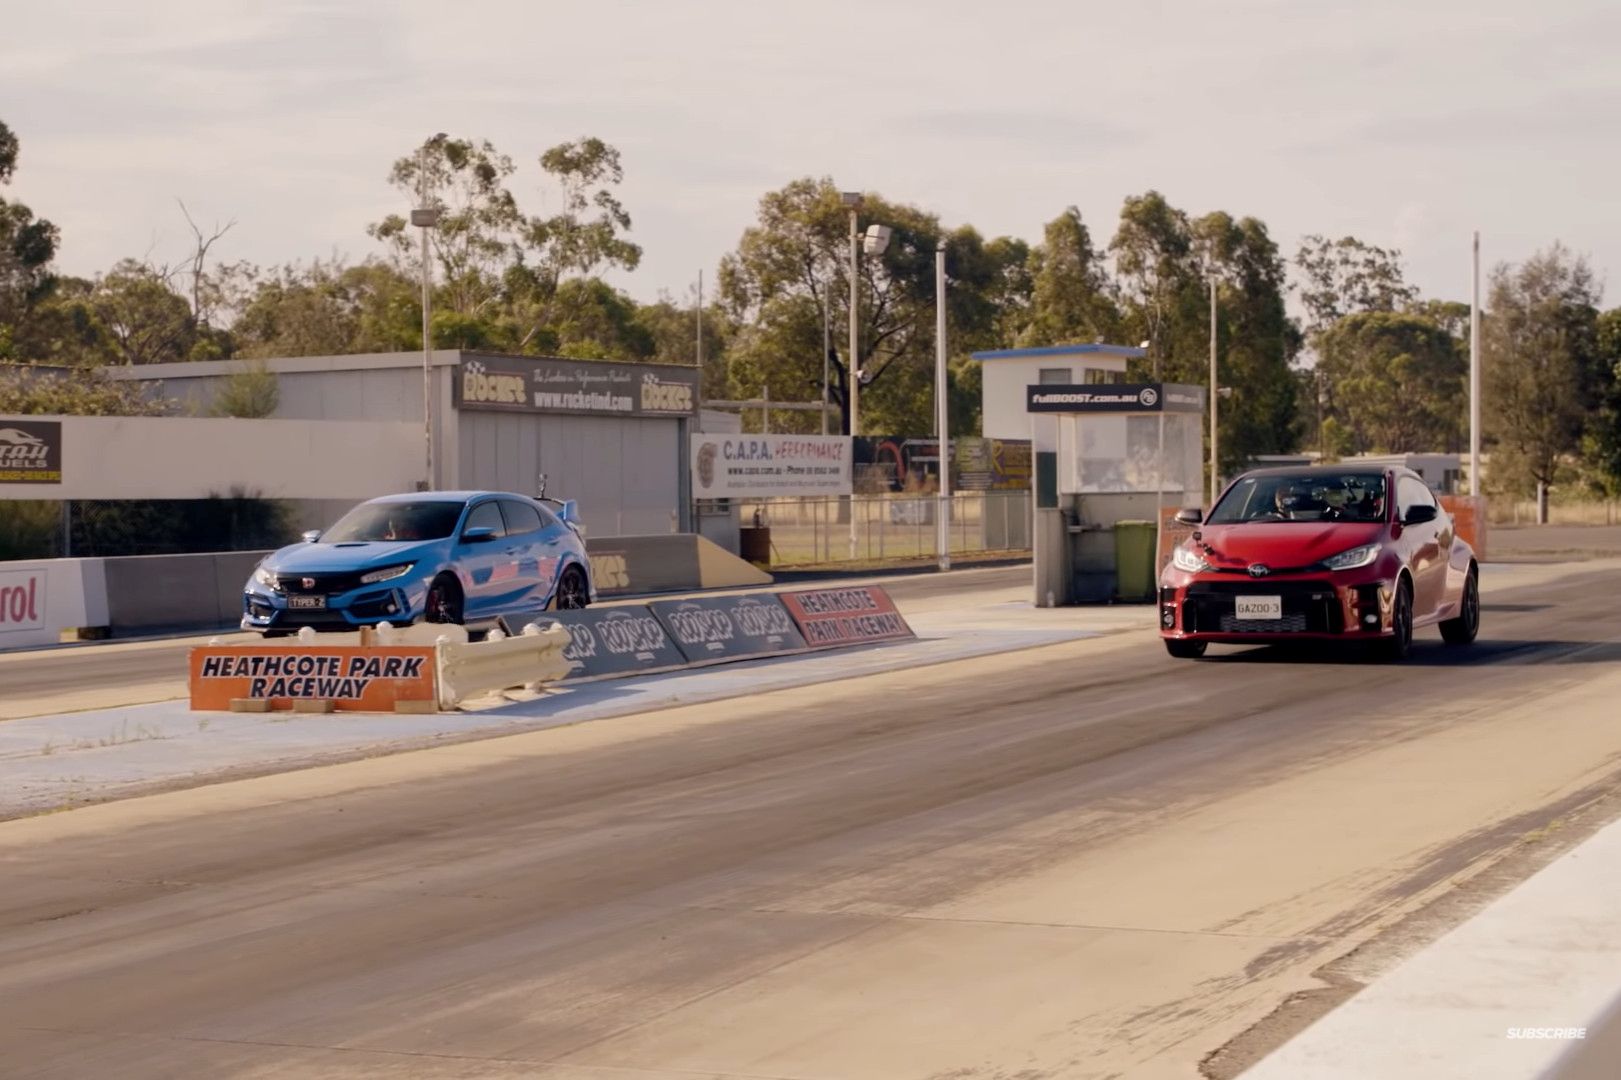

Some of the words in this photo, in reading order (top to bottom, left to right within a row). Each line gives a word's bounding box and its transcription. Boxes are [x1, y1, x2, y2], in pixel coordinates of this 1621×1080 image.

[723, 441, 773, 460] C.A.P.A.
[797, 589, 878, 615] HEATHCOTE
[804, 618, 846, 641] PARK
[841, 611, 902, 639] RACEWAY
[202, 655, 341, 678] HEATHCOTE
[348, 655, 428, 678] PARK
[250, 677, 370, 699] RACEWAY
